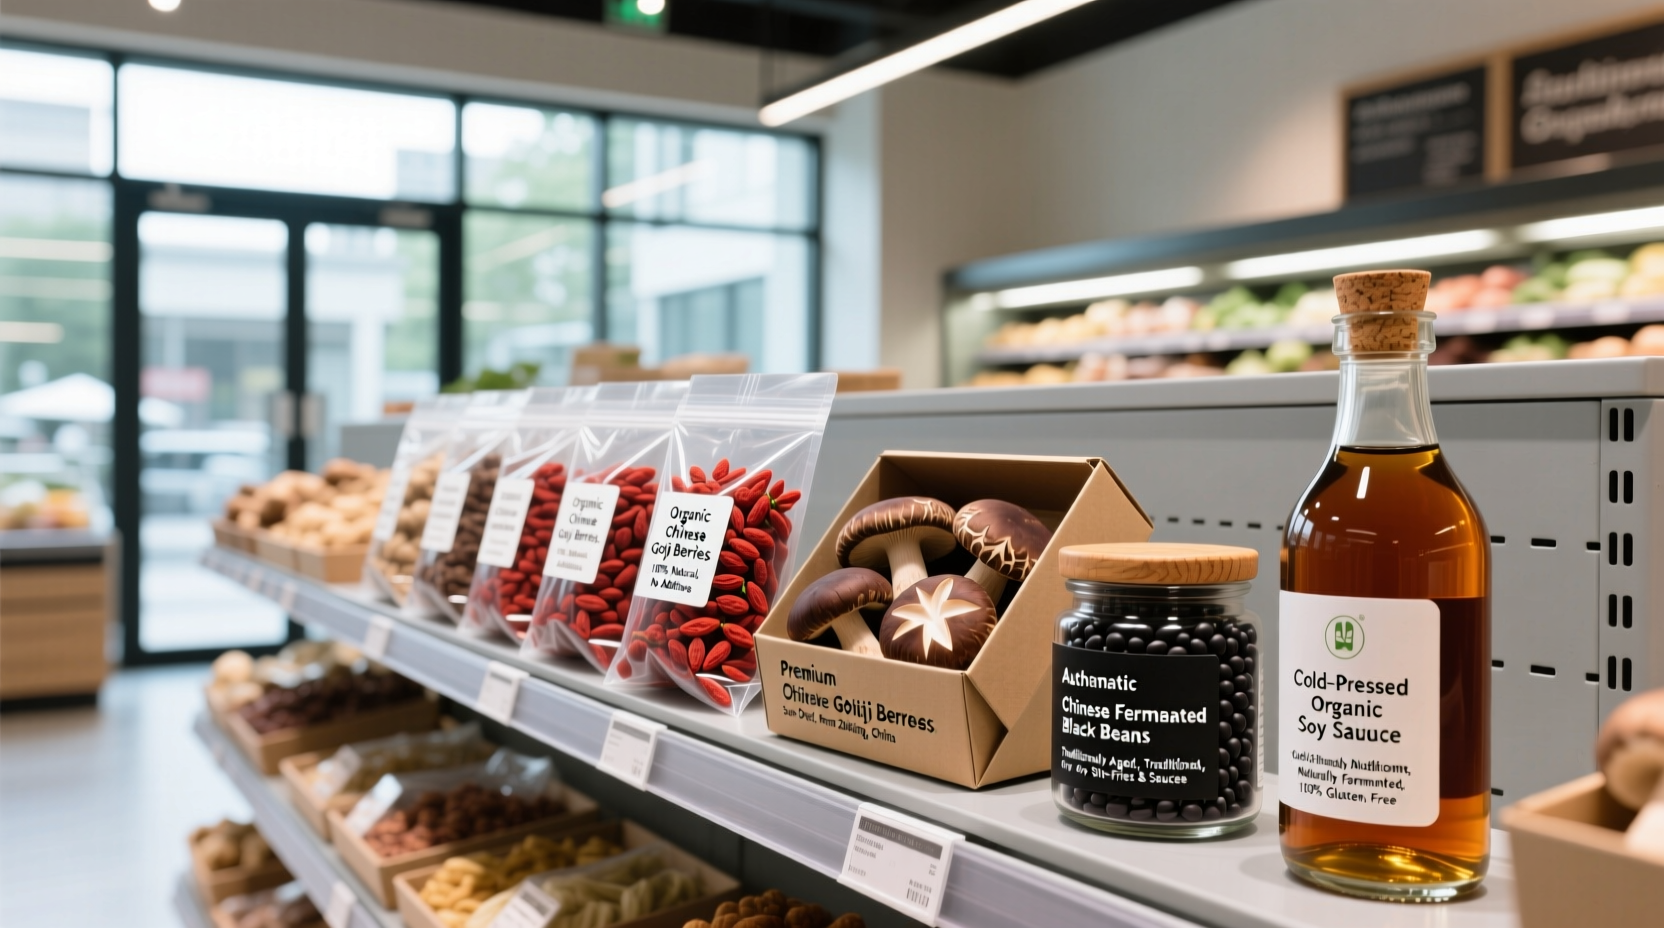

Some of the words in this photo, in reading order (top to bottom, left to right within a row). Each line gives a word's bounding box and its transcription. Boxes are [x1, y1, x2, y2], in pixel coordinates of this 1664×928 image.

[670, 506, 712, 525] Organic
[781, 660, 836, 687] Premium
[1293, 668, 1409, 696] Cold-Pressed
[1062, 696, 1110, 719] Chinese
[1311, 696, 1383, 719] Organic
[1100, 723, 1151, 744] Beans
[1297, 715, 1327, 741] Soy
[1332, 721, 1402, 743] Sauuce
[1371, 793, 1397, 806] Free
